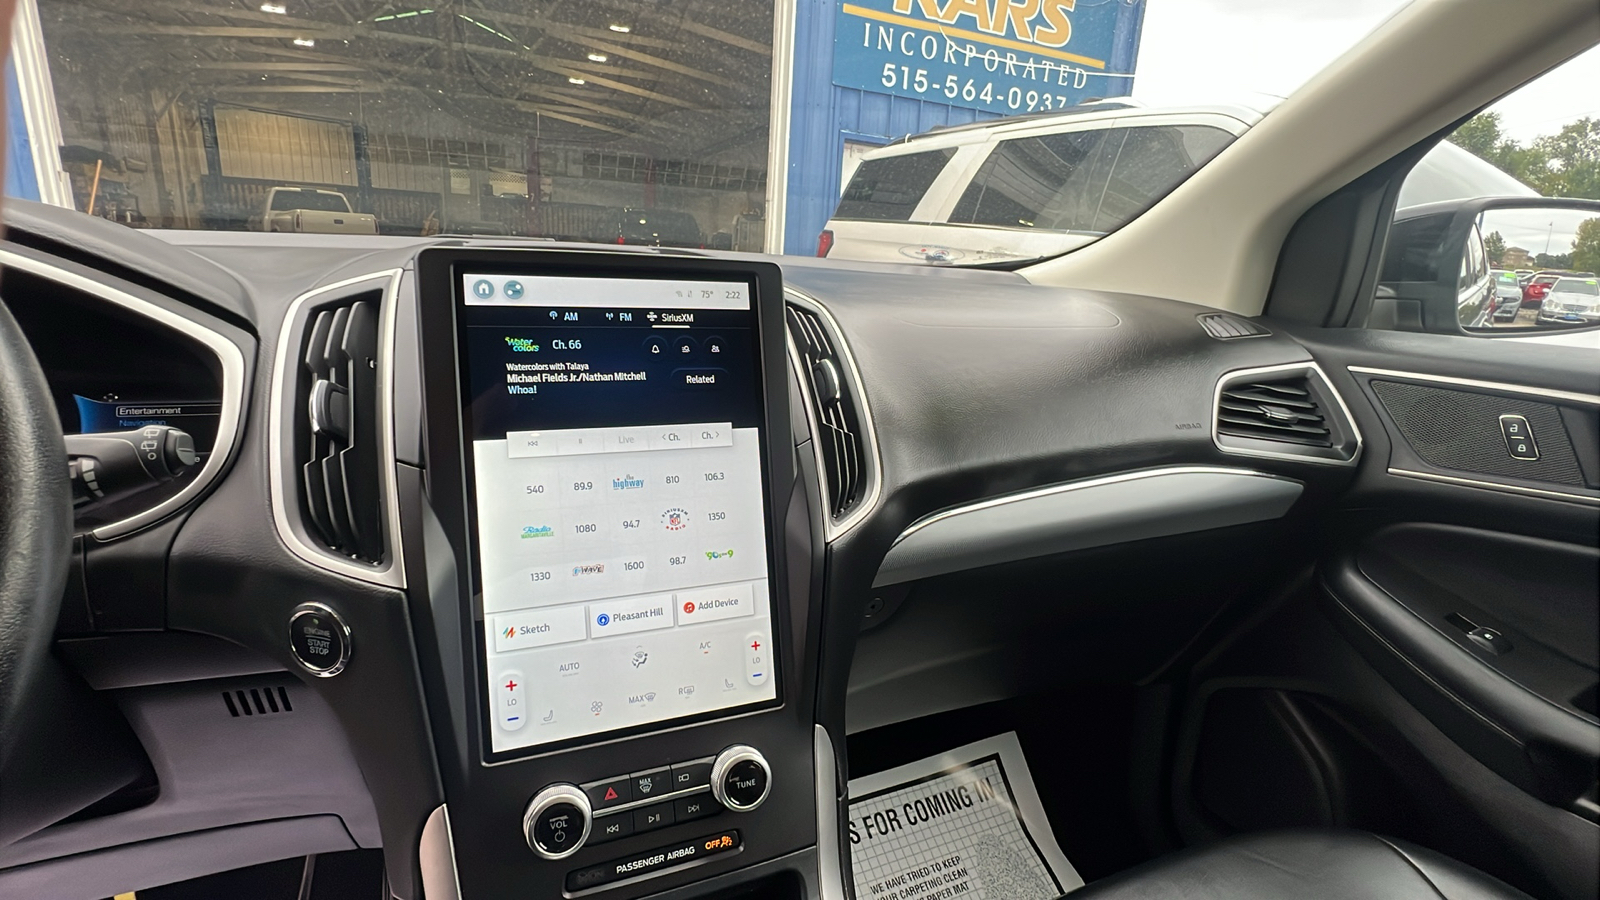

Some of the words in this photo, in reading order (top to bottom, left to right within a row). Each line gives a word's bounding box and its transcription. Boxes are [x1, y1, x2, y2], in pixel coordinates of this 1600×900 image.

[863, 22, 1088, 89] INCORPORATED
[881, 62, 1067, 112] 515-564-0937
[725, 290, 741, 300] 2:22
[563, 312, 579, 321] AM
[619, 312, 633, 321] FM
[661, 312, 694, 323] SiriusXM
[552, 339, 568, 350] Ch.
[568, 339, 582, 349] 66
[506, 363, 549, 371] Watercolors
[549, 362, 566, 371] with
[566, 362, 590, 372] Talaya
[507, 373, 542, 383] Michael
[542, 373, 568, 382] Fields
[614, 371, 647, 381] Mitchell
[685, 374, 716, 384] Related
[507, 385, 537, 395] Whoa!
[119, 407, 182, 415] Entertainment
[618, 434, 635, 444] Live
[668, 432, 681, 442] Ch.
[701, 430, 714, 440] Ch.
[665, 475, 680, 484] 810
[704, 472, 725, 482] 106.3
[526, 484, 545, 494] 540
[573, 481, 593, 491] 89.9
[612, 478, 645, 490] highway
[708, 511, 726, 521] 1350
[575, 523, 597, 534] 1080
[622, 519, 640, 529] 94.7
[624, 561, 645, 571] 1600
[669, 556, 687, 566] 98.7
[530, 571, 551, 582] 1330
[698, 600, 713, 611] Add
[714, 597, 739, 609] Device
[613, 610, 648, 623] Pleasant
[650, 607, 664, 618] Hill
[520, 623, 550, 635] Sketch
[307, 639, 331, 648] START
[699, 641, 712, 650] A/C
[309, 647, 329, 655] STOP
[752, 656, 761, 665] LO
[559, 662, 580, 672] AUTO
[507, 698, 517, 707] LO
[628, 694, 645, 704] MAX
[736, 778, 756, 789] TUNE
[862, 808, 902, 839] FOR
[903, 785, 973, 826] COMING
[973, 777, 995, 803] IN
[550, 820, 568, 829] VOL
[616, 854, 665, 874] PASSENGER
[667, 846, 695, 861] AIRBAG
[705, 839, 721, 850] OFF
[870, 883, 885, 895] WE
[885, 874, 907, 890] HAVE
[906, 866, 930, 881] TRIED
[930, 862, 942, 873] TO
[942, 855, 961, 869] KEEP
[877, 892, 899, 900] OUR
[899, 876, 943, 899] CARPETING
[943, 867, 968, 883] CLEAN
[953, 881, 970, 894] MAT
